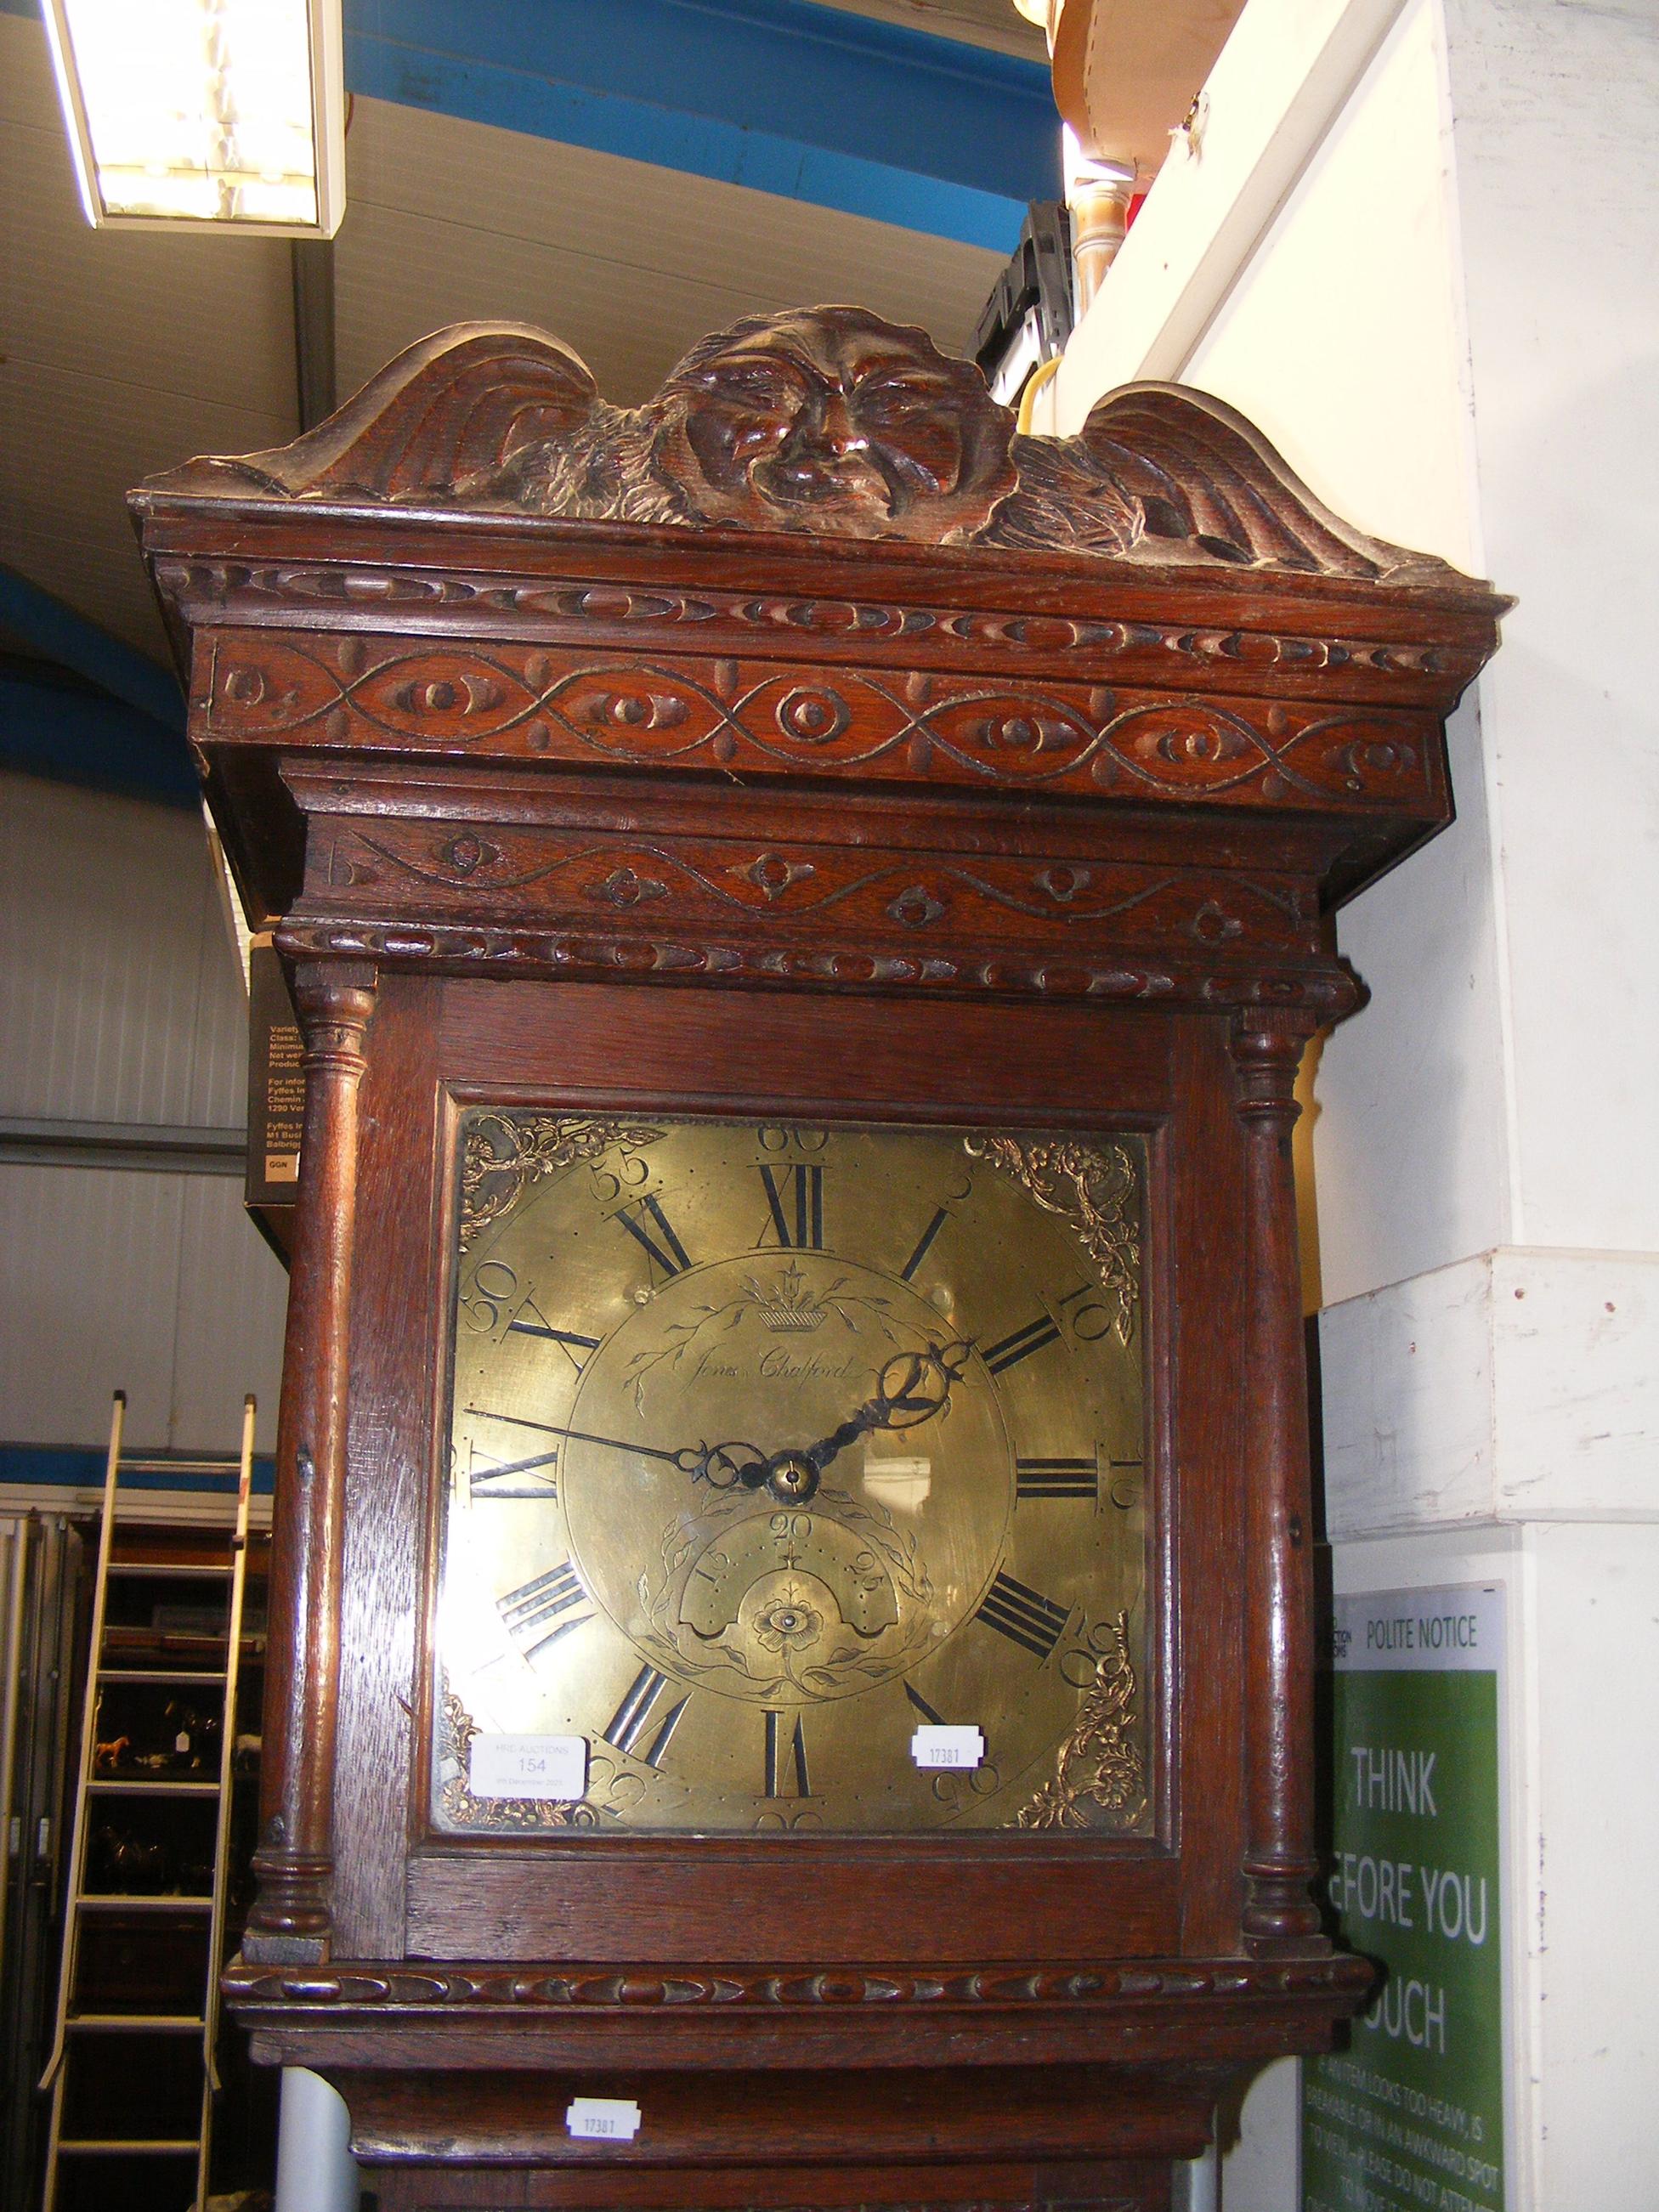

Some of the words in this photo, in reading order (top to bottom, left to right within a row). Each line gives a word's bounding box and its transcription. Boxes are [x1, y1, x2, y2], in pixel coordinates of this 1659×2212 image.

[268, 1078, 284, 1086] For
[267, 1095, 301, 1104] Chemin
[268, 1087, 295, 1096] Fyffes
[266, 1123, 294, 1132] Fyffes
[269, 1160, 288, 1168] GGN
[770, 1513, 813, 1540] 20
[694, 1548, 731, 1589] 15
[849, 1550, 885, 1593] 25
[1367, 1618, 1414, 1649] POLITE
[1418, 1615, 1477, 1649] NOTICE
[518, 1745, 569, 1755] AUCTIONS
[930, 1748, 959, 1763] 17381
[519, 1757, 546, 1773] 154
[1350, 1747, 1437, 1817] THINK
[1420, 1866, 1486, 1944] YOU
[584, 2118, 616, 2134] 17381
